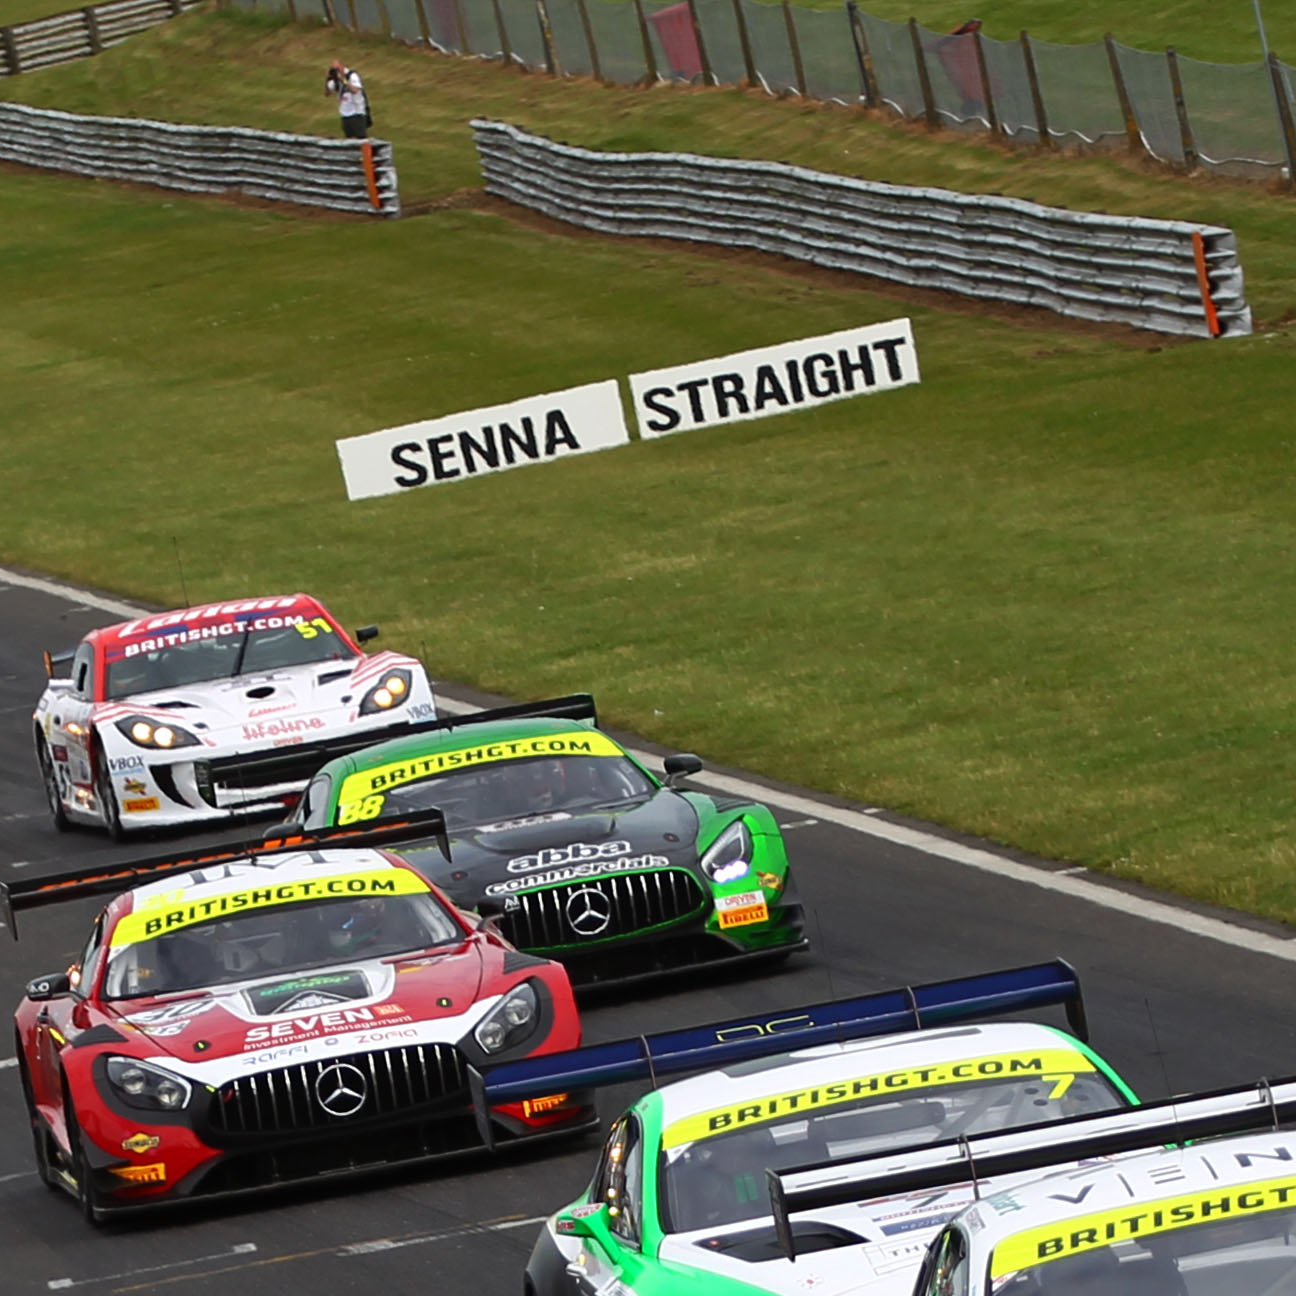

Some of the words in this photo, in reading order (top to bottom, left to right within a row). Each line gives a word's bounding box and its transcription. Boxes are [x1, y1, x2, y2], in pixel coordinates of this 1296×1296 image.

[390, 408, 581, 487] SENNA
[642, 336, 906, 432] STRAIGHT
[124, 614, 304, 658] BRITISHGT.COM
[293, 616, 335, 640] 51
[108, 754, 145, 772] VBOX
[370, 739, 592, 790] BRITISHGT.COM
[339, 795, 387, 826] 88
[506, 840, 632, 873] abba
[484, 854, 670, 896] commercials
[144, 877, 397, 935] BRITISHGT.COM
[244, 1007, 375, 1042] SEVEN
[323, 1014, 413, 1034] Management
[708, 1057, 1045, 1132] BRITISHGT.COM
[1040, 1073, 1079, 1099] 7
